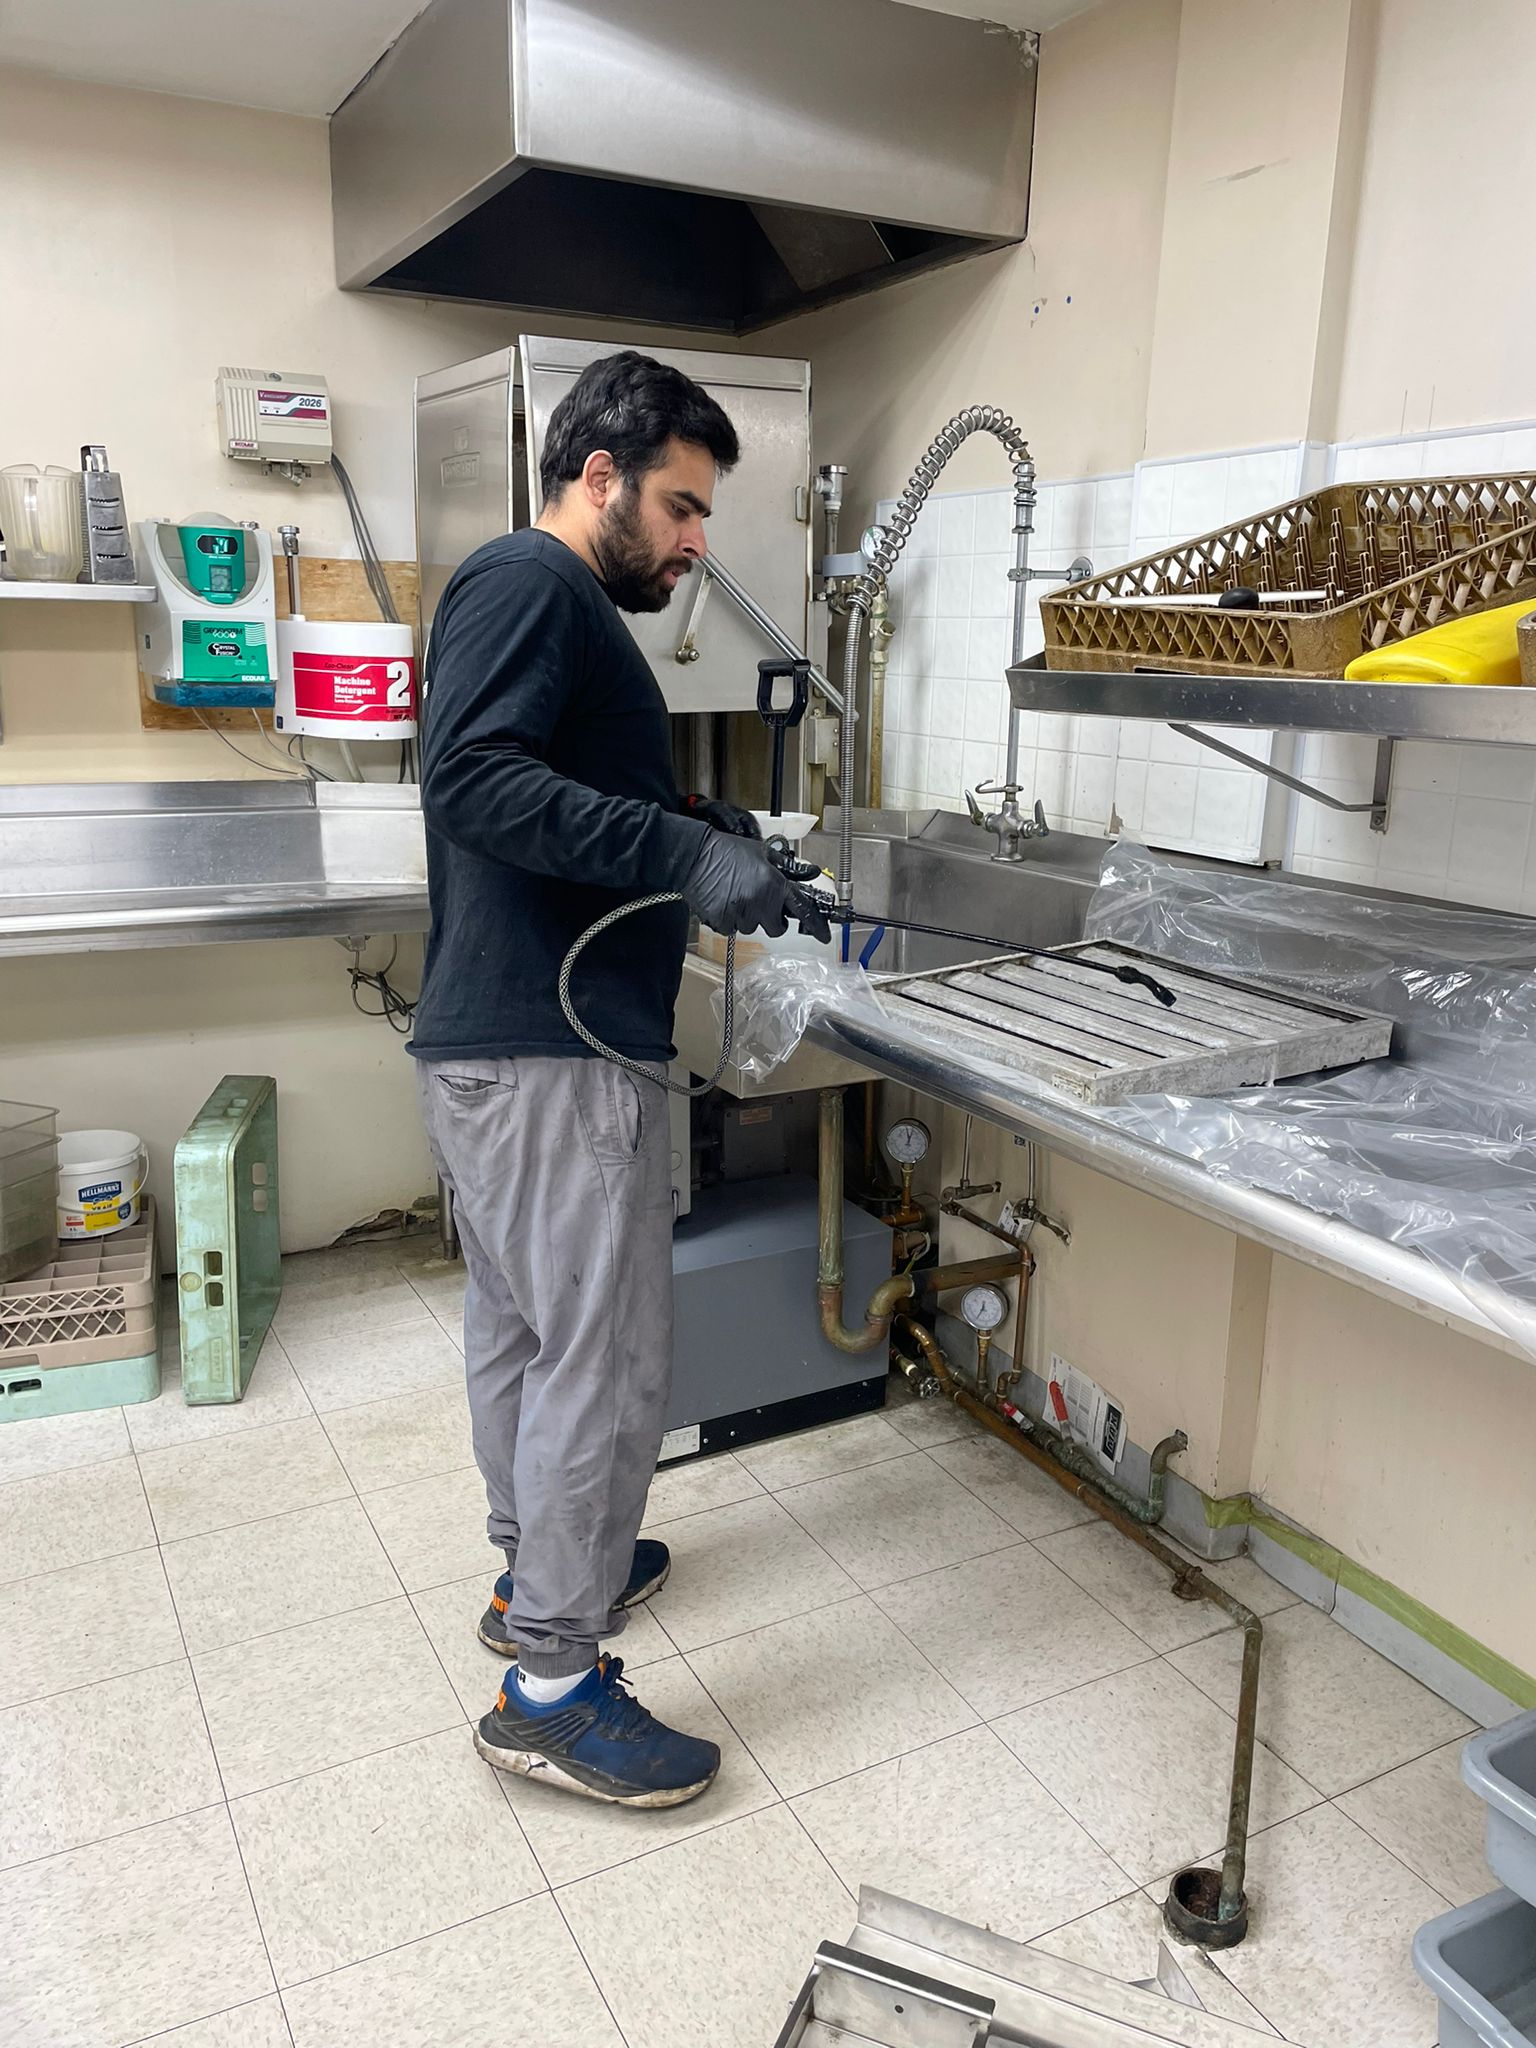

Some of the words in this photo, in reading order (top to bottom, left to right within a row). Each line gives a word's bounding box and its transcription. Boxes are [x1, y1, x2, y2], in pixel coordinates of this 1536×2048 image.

[299, 397, 322, 408] 2026
[334, 676, 371, 686] Machine
[387, 660, 411, 707] 2
[334, 685, 376, 697] Detergent
